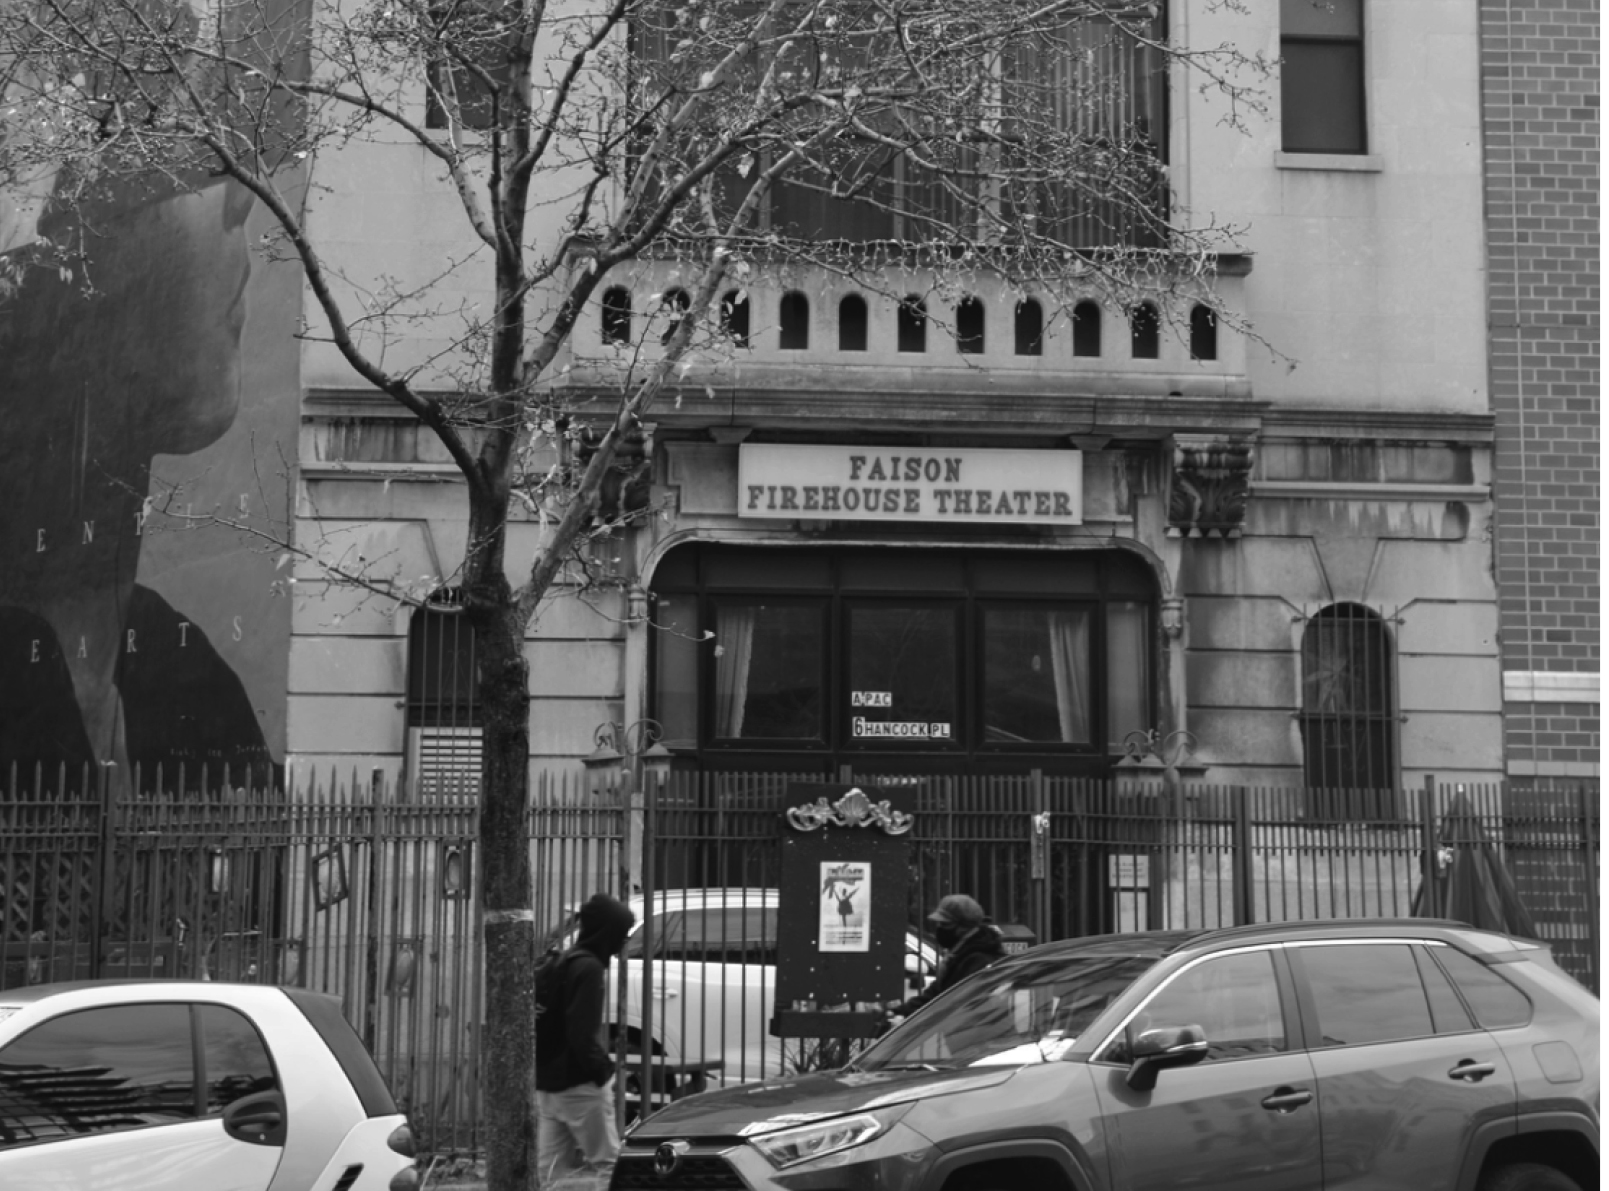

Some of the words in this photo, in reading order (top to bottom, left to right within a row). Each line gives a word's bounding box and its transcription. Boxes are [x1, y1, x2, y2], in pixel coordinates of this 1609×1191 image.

[849, 456, 962, 481] FAISON
[747, 485, 920, 513] FIREHOUSE
[933, 490, 1073, 516] THEATER
[865, 723, 926, 735] HANCOCK
[932, 724, 949, 736] PL
